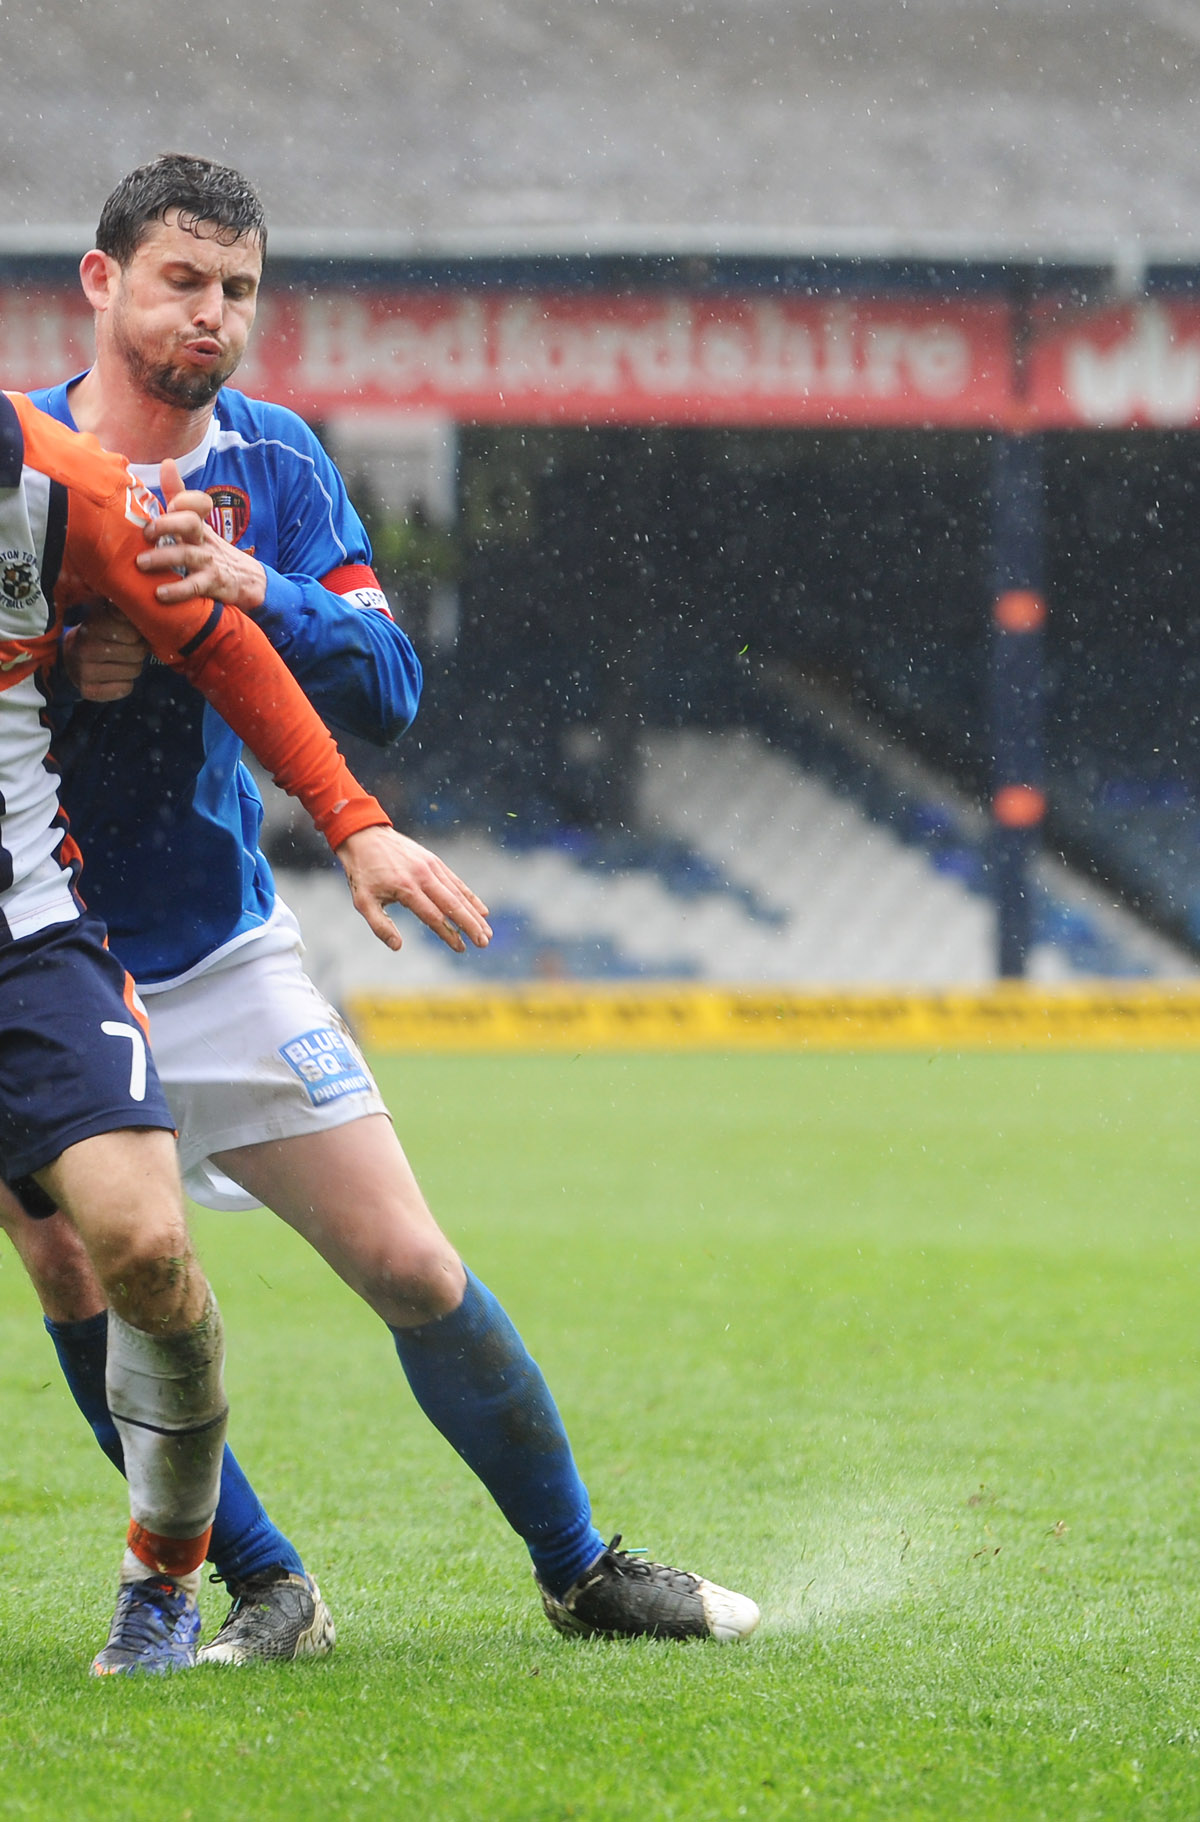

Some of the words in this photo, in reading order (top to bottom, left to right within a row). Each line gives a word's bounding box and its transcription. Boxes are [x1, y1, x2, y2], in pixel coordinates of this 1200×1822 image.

[298, 296, 972, 400] Bedfordshire
[22, 551, 37, 565] TO
[101, 1021, 147, 1102] 7
[284, 1031, 345, 1064] BLUE
